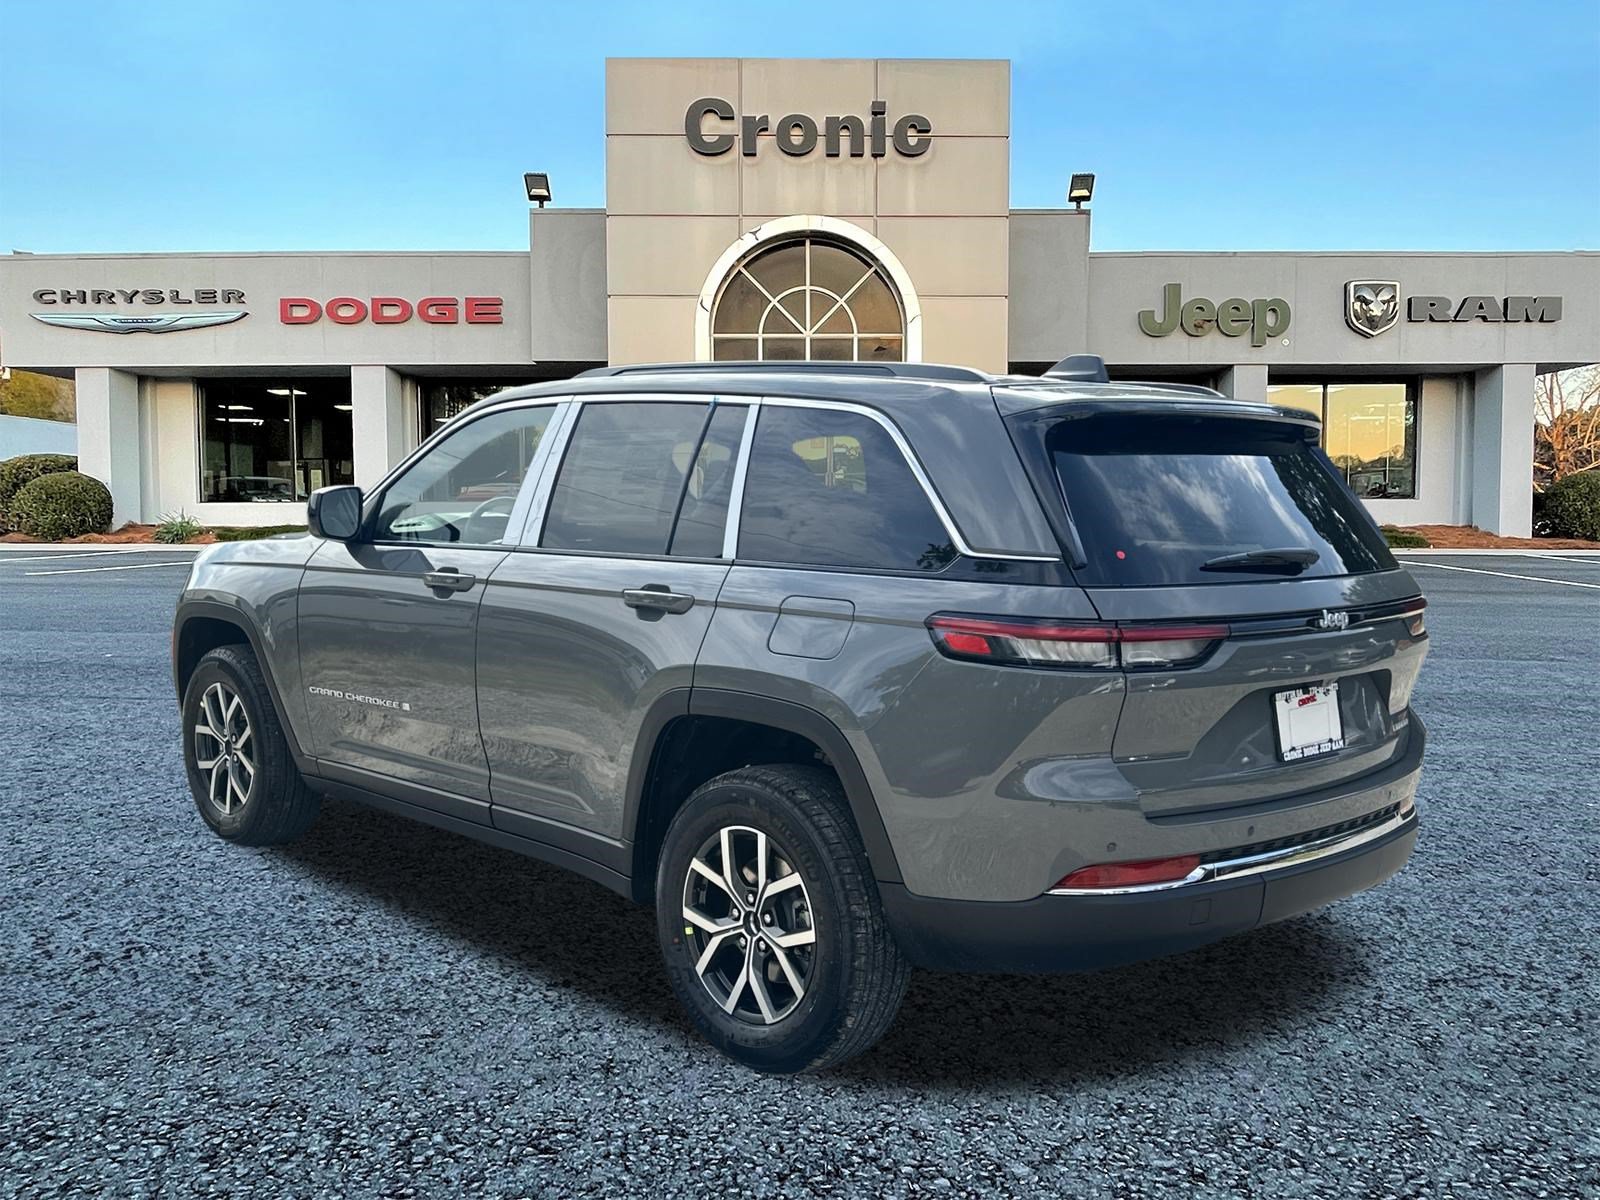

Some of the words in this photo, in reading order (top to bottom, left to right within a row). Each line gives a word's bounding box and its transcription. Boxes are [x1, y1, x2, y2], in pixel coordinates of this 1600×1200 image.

[685, 97, 932, 158] Cronic
[32, 288, 246, 305] CHRYSLER
[1407, 296, 1563, 323] RAM
[280, 297, 504, 325] DODGE
[1139, 283, 1292, 347] Jeep
[1319, 610, 1349, 630] Jeep
[309, 686, 343, 699] GRAND
[345, 692, 400, 709] CHEROKEE
